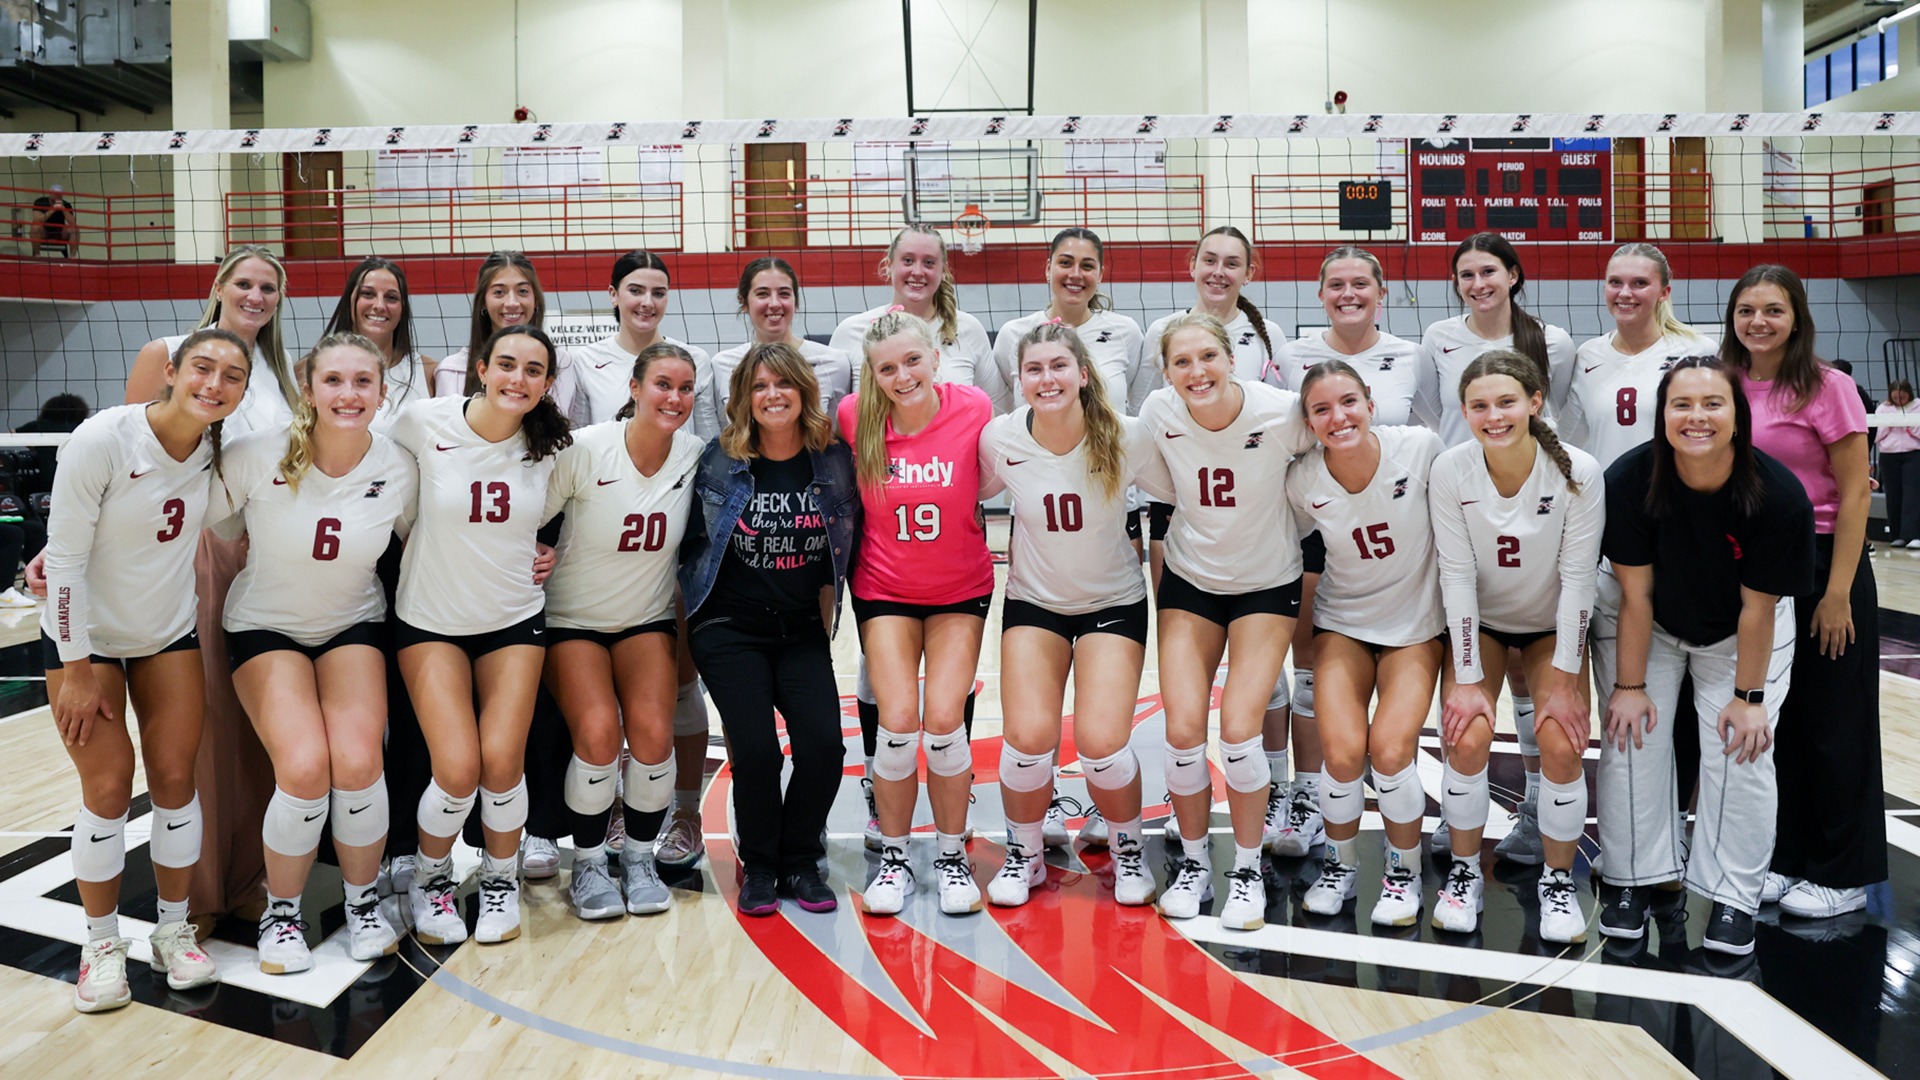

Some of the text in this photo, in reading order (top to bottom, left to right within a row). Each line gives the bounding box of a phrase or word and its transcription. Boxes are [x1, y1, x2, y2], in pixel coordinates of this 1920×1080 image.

[1419, 153, 1466, 166] HOUNDS
[1497, 162, 1525, 171] PERIOD
[1561, 153, 1597, 165] GUEST
[1346, 185, 1378, 200] 00.0
[1421, 198, 1446, 207] FOULS
[1455, 198, 1477, 207] T.O.L.
[1484, 198, 1539, 207] PLAYER FOUL
[1578, 198, 1602, 207] FOULS
[1421, 232, 1446, 241] SCORE
[1578, 231, 1603, 240] SCORE
[551, 334, 611, 344] WRESTLIN
[1616, 387, 1637, 426] 8
[1197, 467, 1236, 507] 12
[469, 481, 511, 523] 13
[749, 492, 792, 513] HECK
[1043, 493, 1083, 532] 10
[157, 498, 185, 543] 3
[751, 513, 826, 535] they're FAK
[894, 503, 941, 542] 19
[312, 517, 342, 561] 6
[617, 512, 667, 552] 20
[1351, 522, 1396, 560] 15
[732, 533, 756, 552] THE
[763, 536, 797, 553] REAL
[1497, 535, 1521, 568] 2
[763, 553, 775, 569] to
[776, 554, 806, 570] KILL
[58, 586, 71, 642] INDIANAPOLIS
[1462, 616, 1473, 667] INDIANAPOLIS
